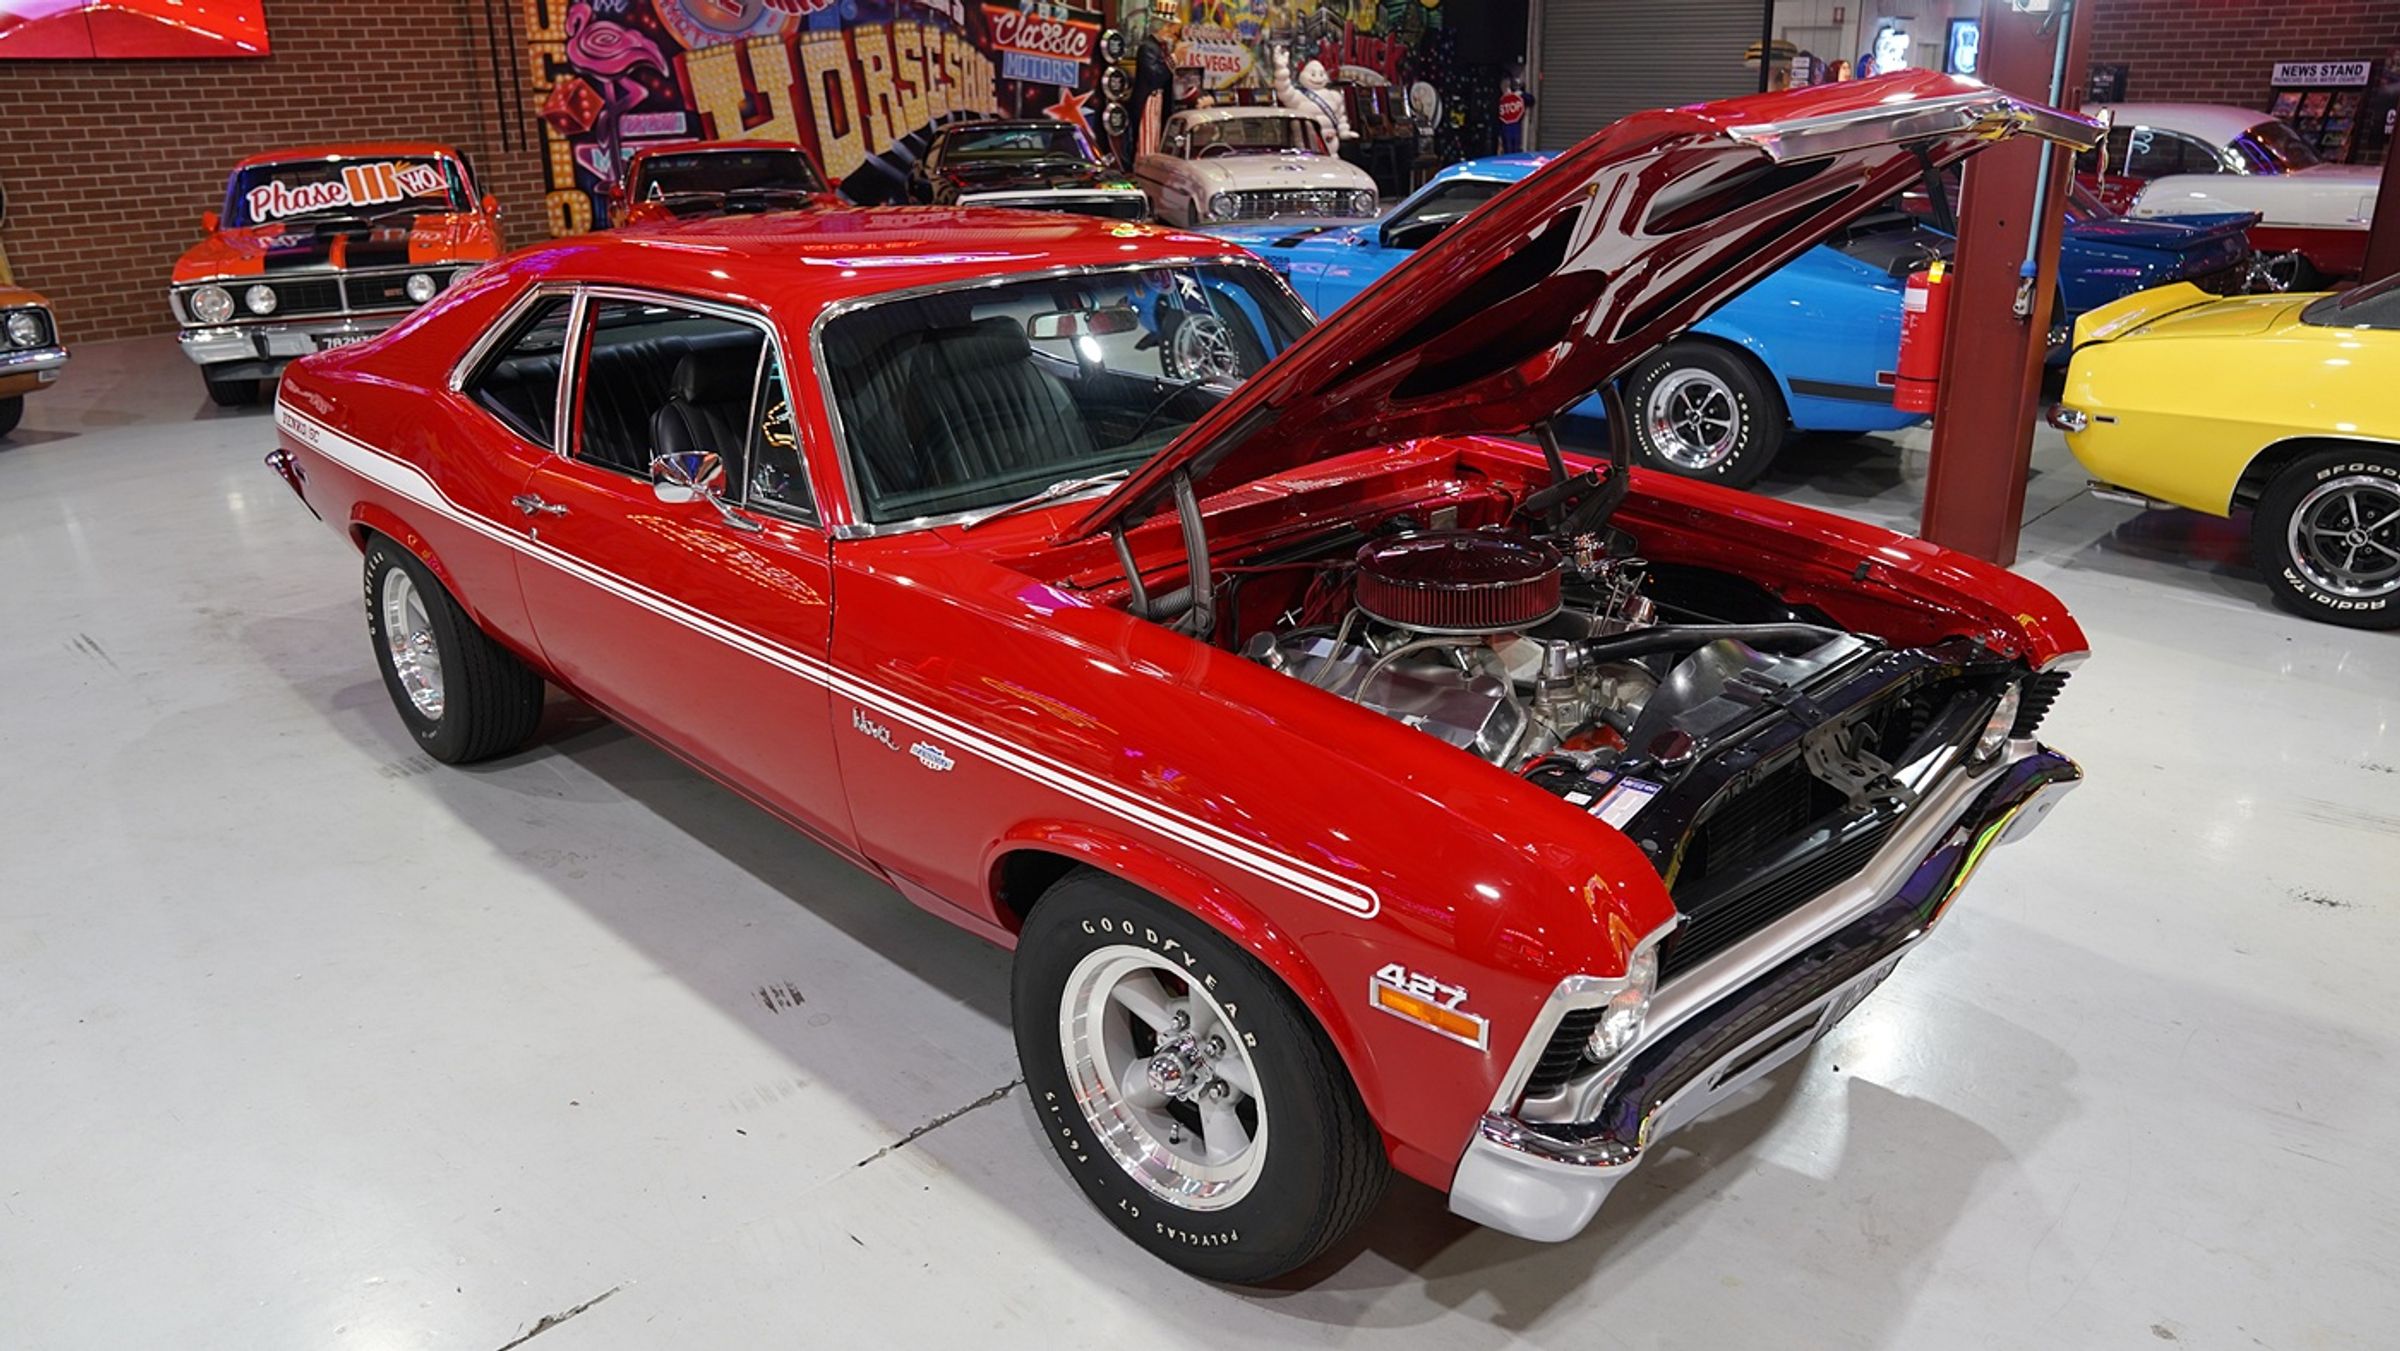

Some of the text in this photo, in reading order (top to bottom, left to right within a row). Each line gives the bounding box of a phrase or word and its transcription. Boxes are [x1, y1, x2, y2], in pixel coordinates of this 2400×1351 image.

[993, 11, 1088, 57] Classic
[1005, 51, 1074, 85] MOTORS
[1204, 54, 1241, 72] VEGAS
[2280, 63, 2364, 77] NEWS STAND
[1499, 101, 1523, 117] STOP
[249, 181, 347, 221] Phase
[1082, 917, 1258, 1048] GOODYEAR
[1376, 962, 1469, 1010] 427
[1118, 1198, 1140, 1219] GT
[1156, 1222, 1239, 1247] POLYGLAS
